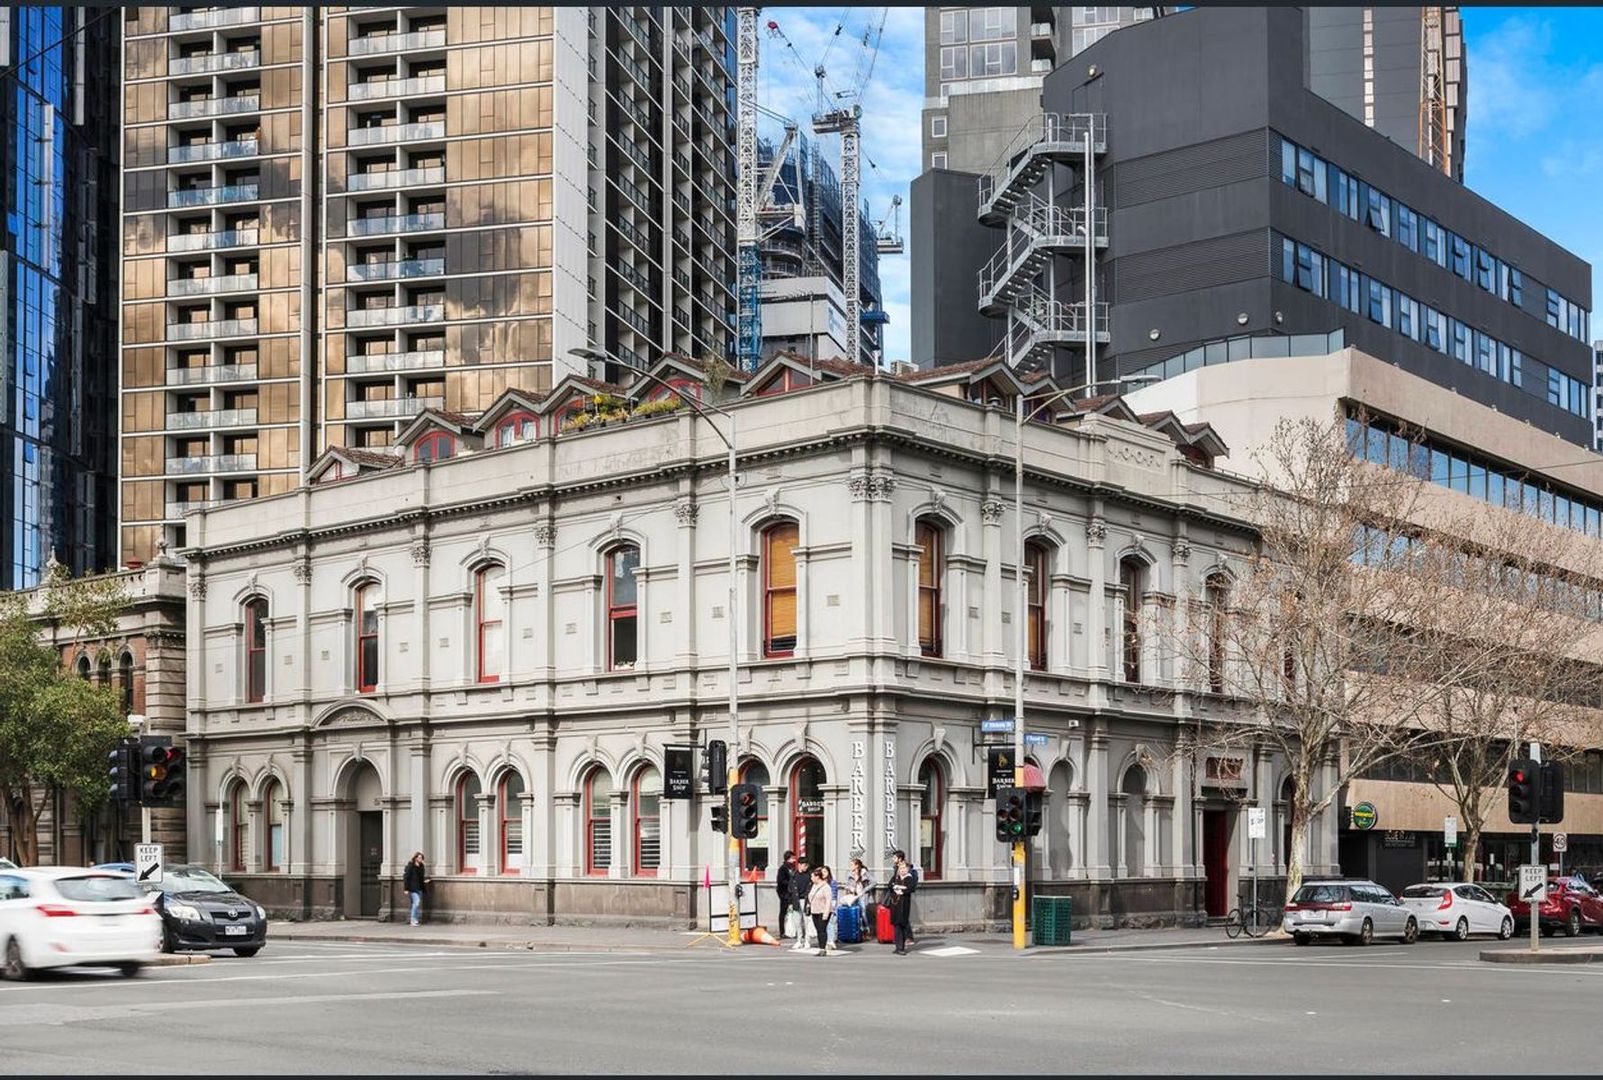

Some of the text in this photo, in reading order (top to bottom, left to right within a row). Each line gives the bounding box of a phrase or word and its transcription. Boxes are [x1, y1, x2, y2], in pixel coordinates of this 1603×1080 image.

[851, 741, 865, 850] BARBER
[884, 741, 897, 850] BARBER
[140, 846, 158, 854] KEEP
[140, 855, 158, 863] LEFT
